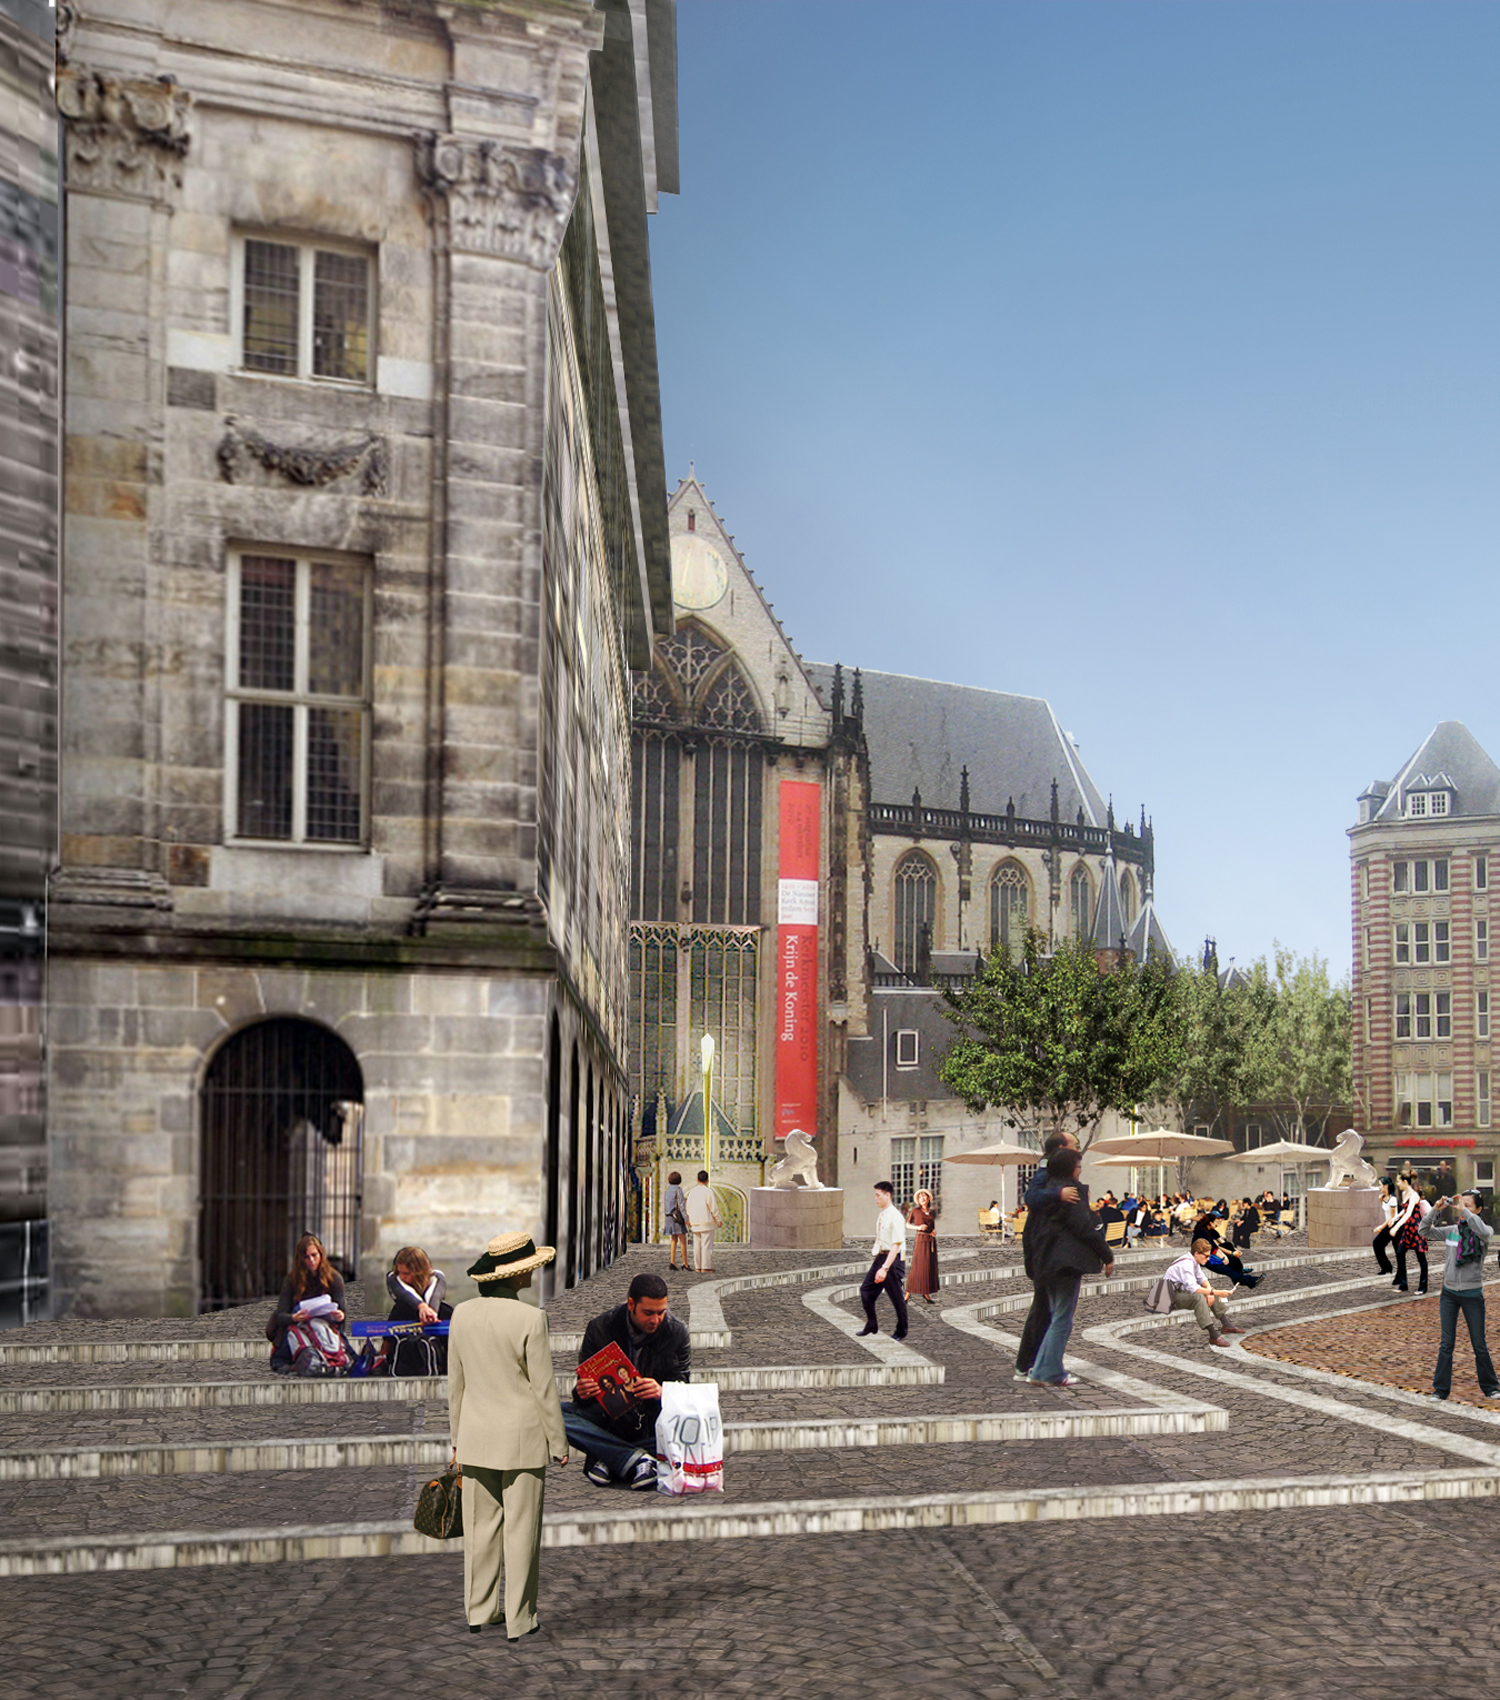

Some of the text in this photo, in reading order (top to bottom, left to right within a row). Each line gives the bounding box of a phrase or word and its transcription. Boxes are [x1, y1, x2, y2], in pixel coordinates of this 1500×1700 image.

[780, 935, 798, 1041] Krijn de Koning
